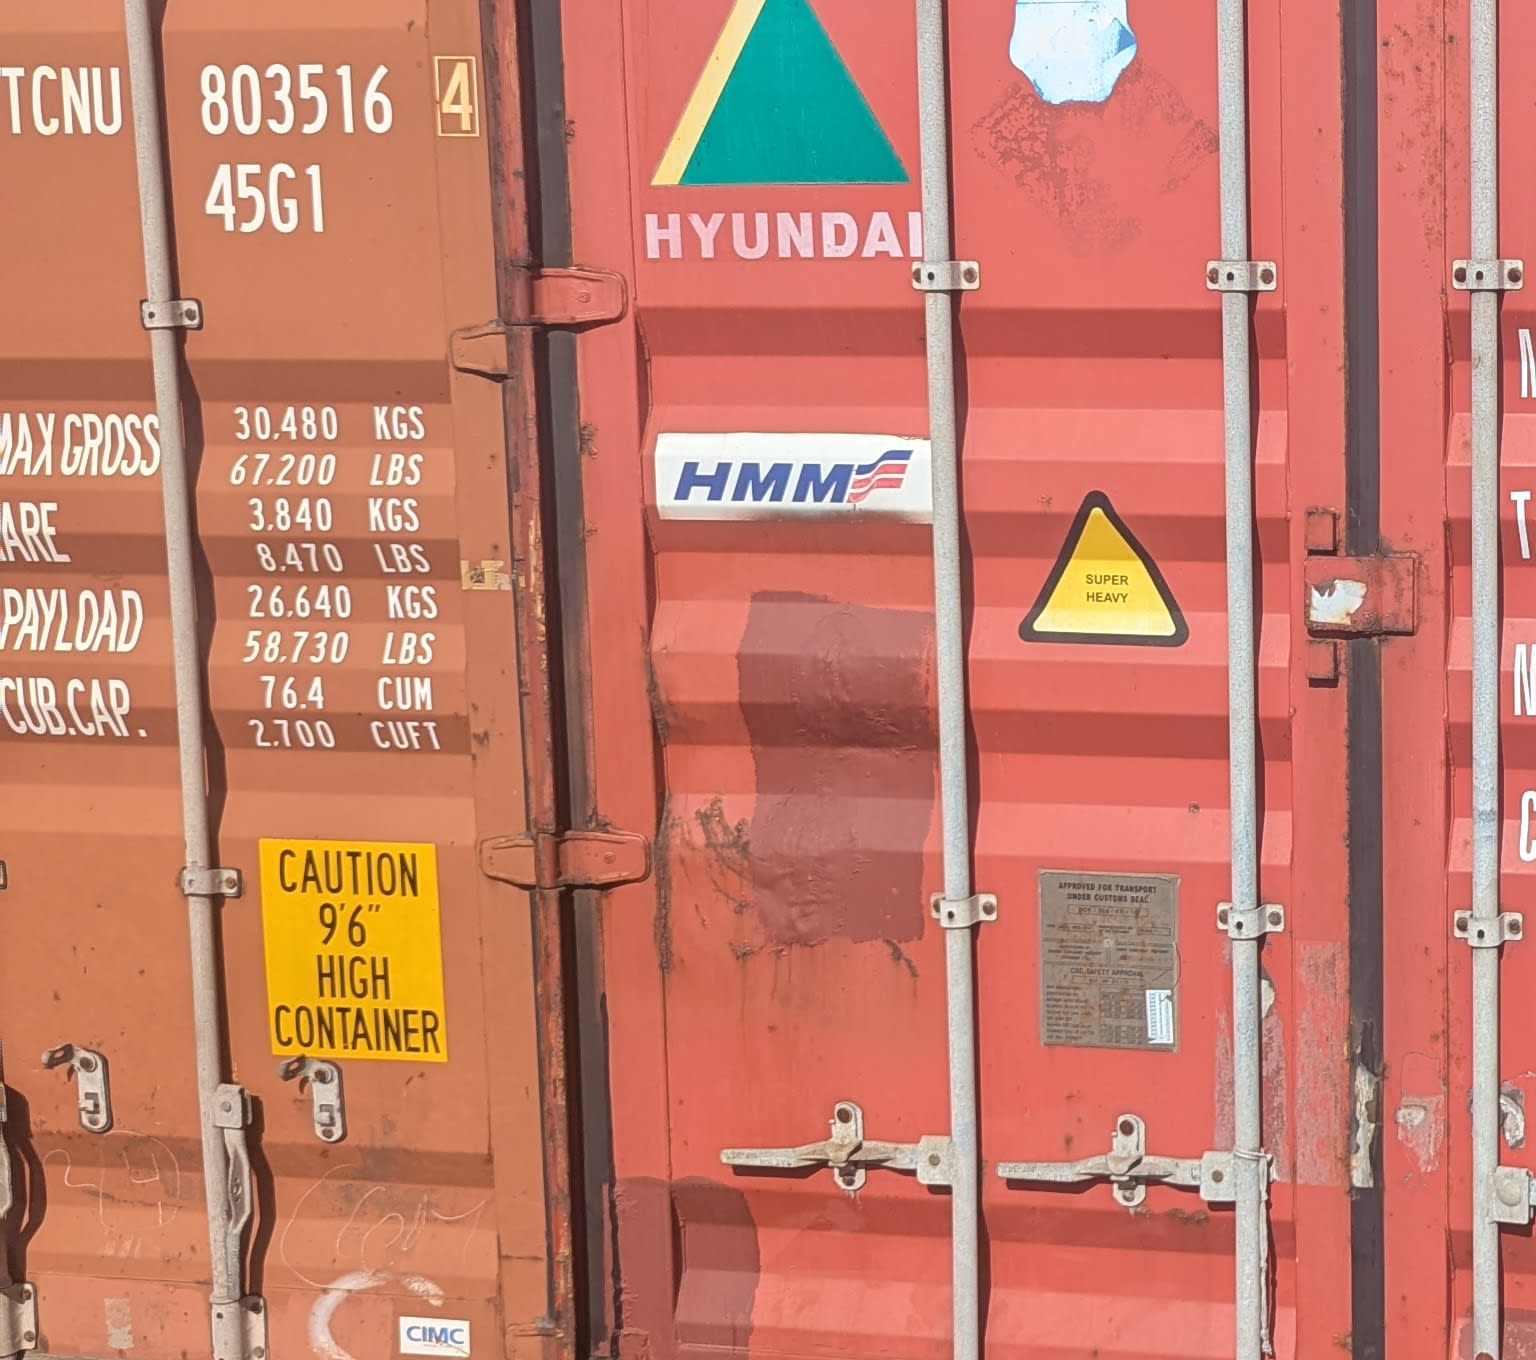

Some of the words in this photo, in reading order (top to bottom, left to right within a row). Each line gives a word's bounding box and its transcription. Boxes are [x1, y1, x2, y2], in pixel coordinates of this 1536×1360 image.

[0, 66, 121, 135] TCNU
[201, 64, 392, 135] 803516
[442, 62, 473, 131] 4
[206, 163, 323, 232] 45G1
[646, 212, 922, 259] HYUNDAI
[61, 413, 160, 477] GROSS
[374, 407, 424, 439] KGS
[370, 454, 423, 485] LBS
[673, 461, 864, 504] HMM
[0, 502, 70, 562] ARE
[369, 498, 419, 531] KGS
[375, 544, 429, 572] LBS
[1085, 573, 1129, 586] SUPER
[0, 589, 143, 652] PAYLOAD
[388, 586, 437, 618] KGS
[1085, 591, 1129, 603] HEAVY
[383, 632, 435, 664] LBS
[0, 678, 147, 737] CUB.CAP.
[261, 676, 323, 709] 76.4
[378, 677, 432, 710] CUM
[371, 721, 440, 749] CUFT
[279, 849, 419, 897] CAUTION
[1058, 882, 1095, 891] APPROVED
[1098, 883, 1113, 892] FOR
[1115, 884, 1157, 894] TRANSPORT
[316, 954, 391, 1000] HIGH
[274, 1005, 441, 1054] CONTAINER
[406, 1325, 465, 1345] CIMC
